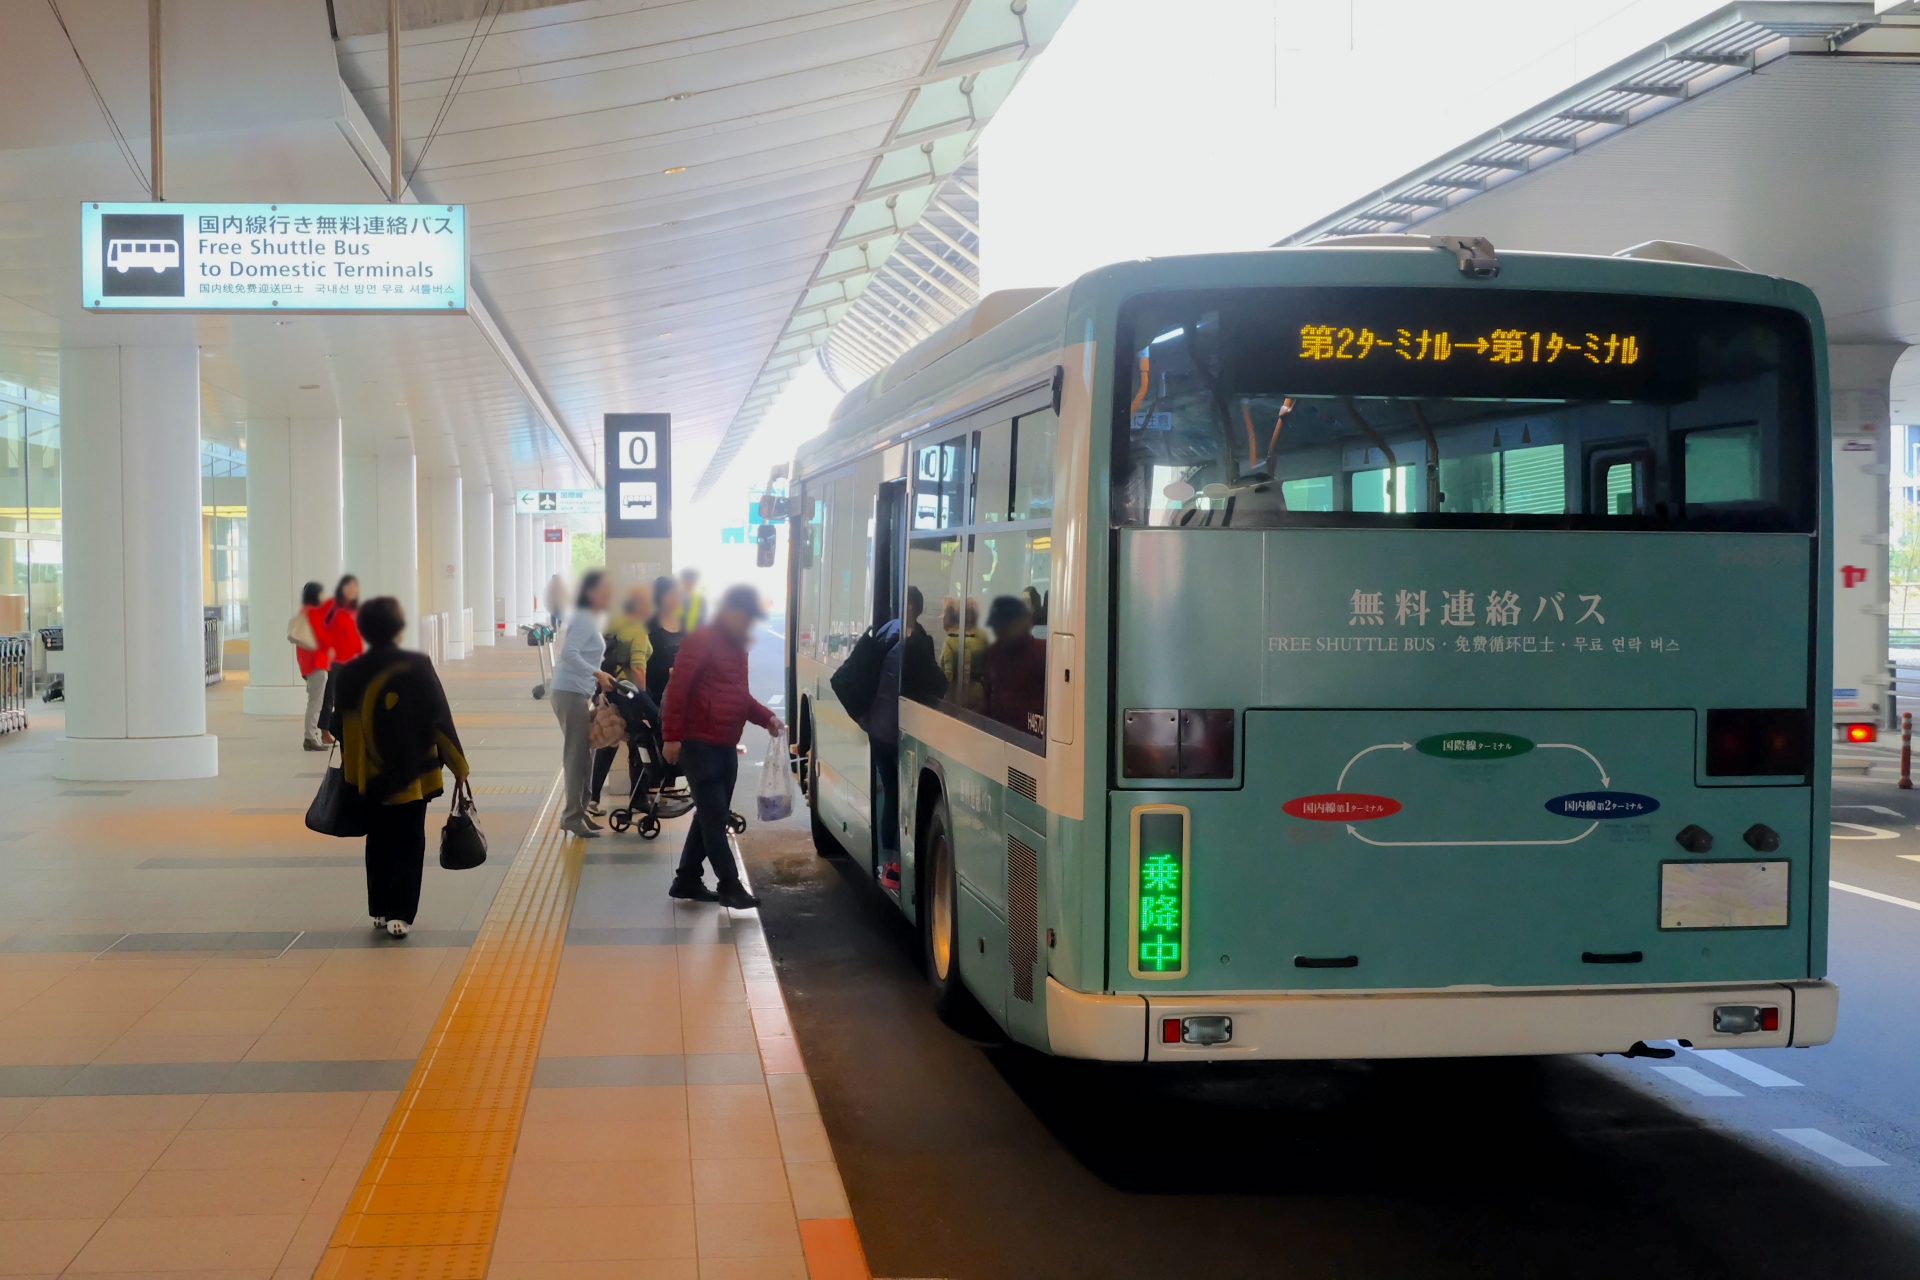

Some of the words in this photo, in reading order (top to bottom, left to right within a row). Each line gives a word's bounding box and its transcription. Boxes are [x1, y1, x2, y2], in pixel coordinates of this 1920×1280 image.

[199, 215, 454, 235] 国内線行き無料連絡バス
[199, 239, 242, 255] Free
[250, 238, 326, 255] Shuttle
[334, 239, 370, 255] Bus
[199, 262, 222, 277] to
[230, 261, 327, 277] Domestic
[333, 261, 434, 277] Terminals
[199, 283, 305, 294] 国内线免费迎送巴士
[315, 283, 349, 294] 국내선
[354, 284, 377, 294] 방면
[381, 284, 404, 294] 무료
[1299, 324, 1452, 361] 第2ターミナル
[1489, 328, 1639, 365] 第1ターミナル
[628, 436, 649, 465] 0
[1348, 588, 1606, 627] 無料連絡バス
[1268, 637, 1312, 652] FREE
[1316, 637, 1398, 652] SHUTTLE
[1403, 637, 1436, 652] BUS
[1454, 635, 1555, 653] 免费循环巴士
[1573, 636, 1604, 653] 무료
[1611, 636, 1643, 653] 연락
[1650, 637, 1681, 653] 버스
[1141, 853, 1180, 972] 乗降中
